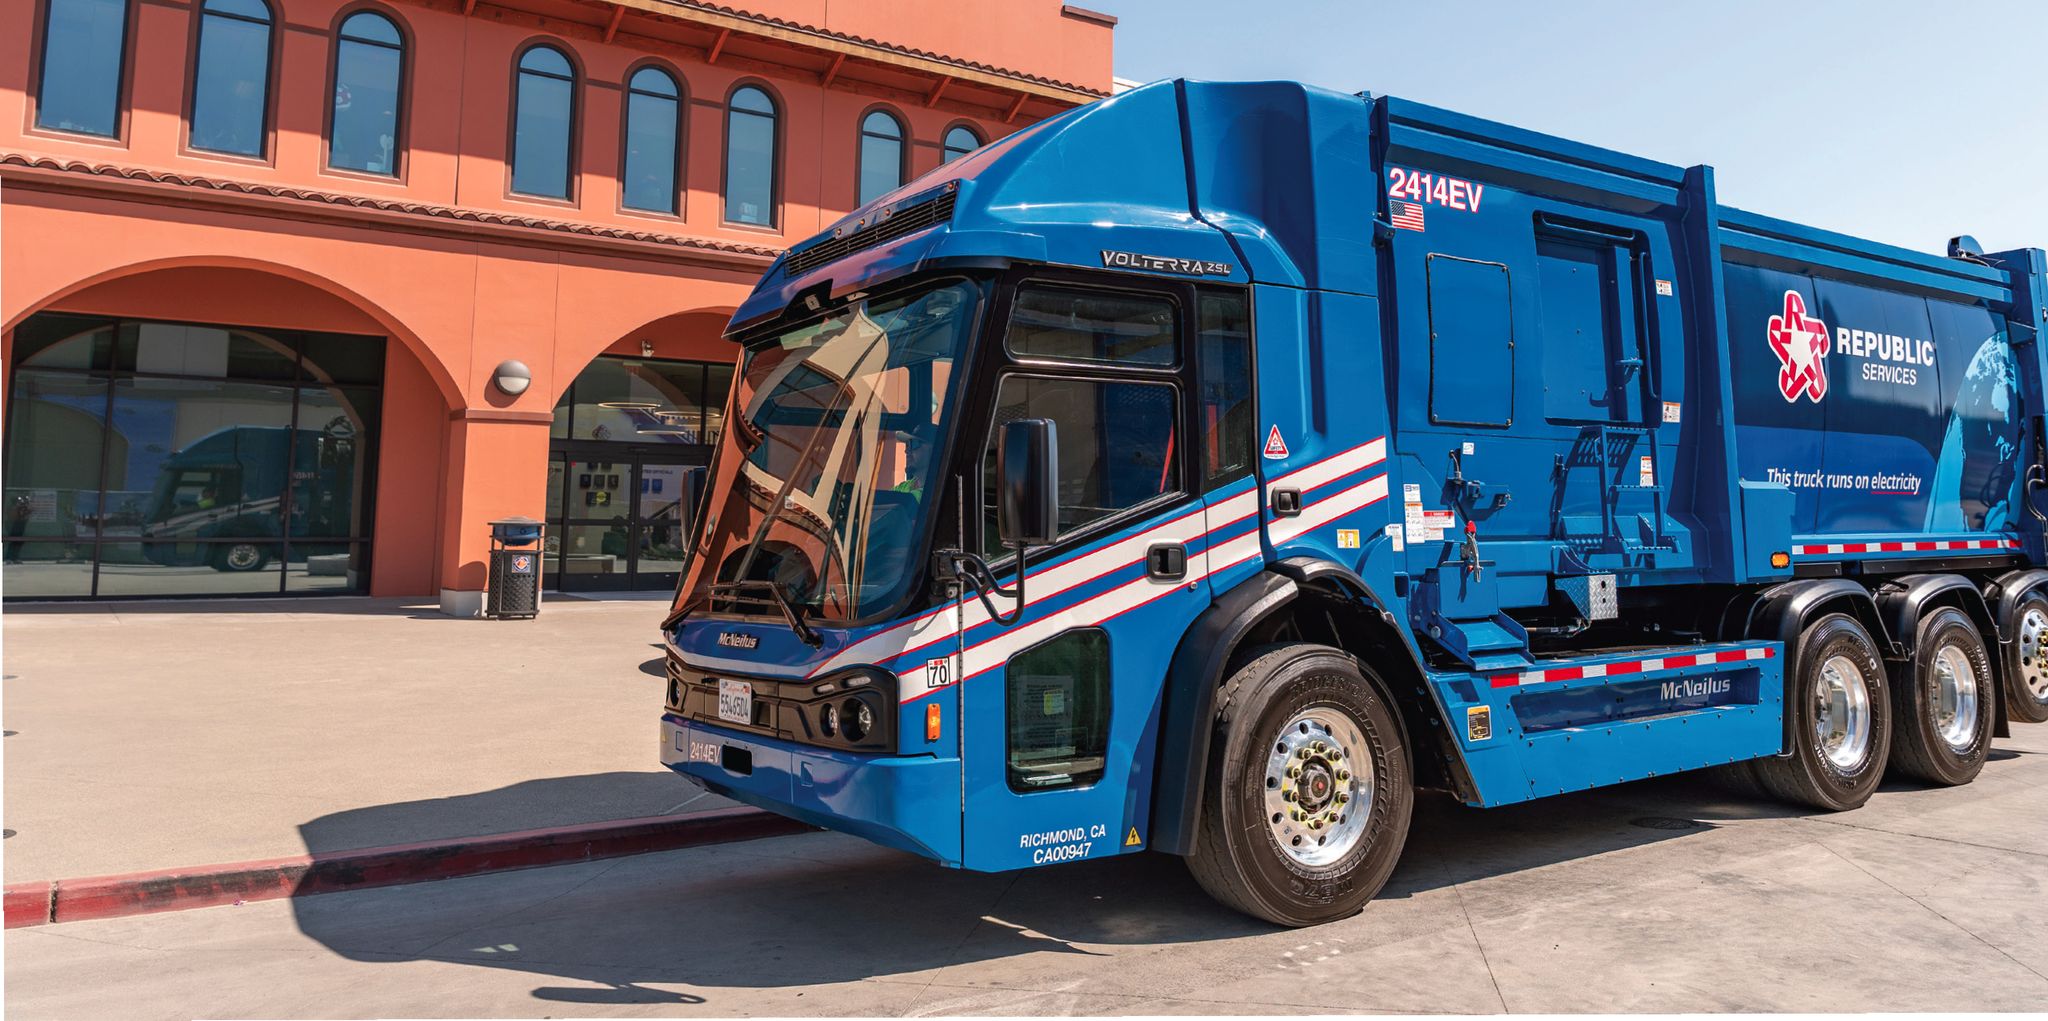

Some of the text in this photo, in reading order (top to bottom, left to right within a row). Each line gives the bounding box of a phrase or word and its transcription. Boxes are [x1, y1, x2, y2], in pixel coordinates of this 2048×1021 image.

[1389, 167, 1484, 214] 2414EV
[1103, 250, 1231, 274] VOLTERRA ZSL
[1837, 327, 1934, 367] REPUBLIC
[1862, 363, 1917, 385] SERVICES
[1767, 468, 1922, 495] This truck runs on electricity
[717, 632, 758, 649] McNeilus
[929, 665, 948, 685] 70
[1660, 677, 1731, 701] McNeilus
[690, 741, 721, 763] 2414EV
[1020, 824, 1107, 848] RICHMOND, CA
[1033, 842, 1093, 864] CA00947
